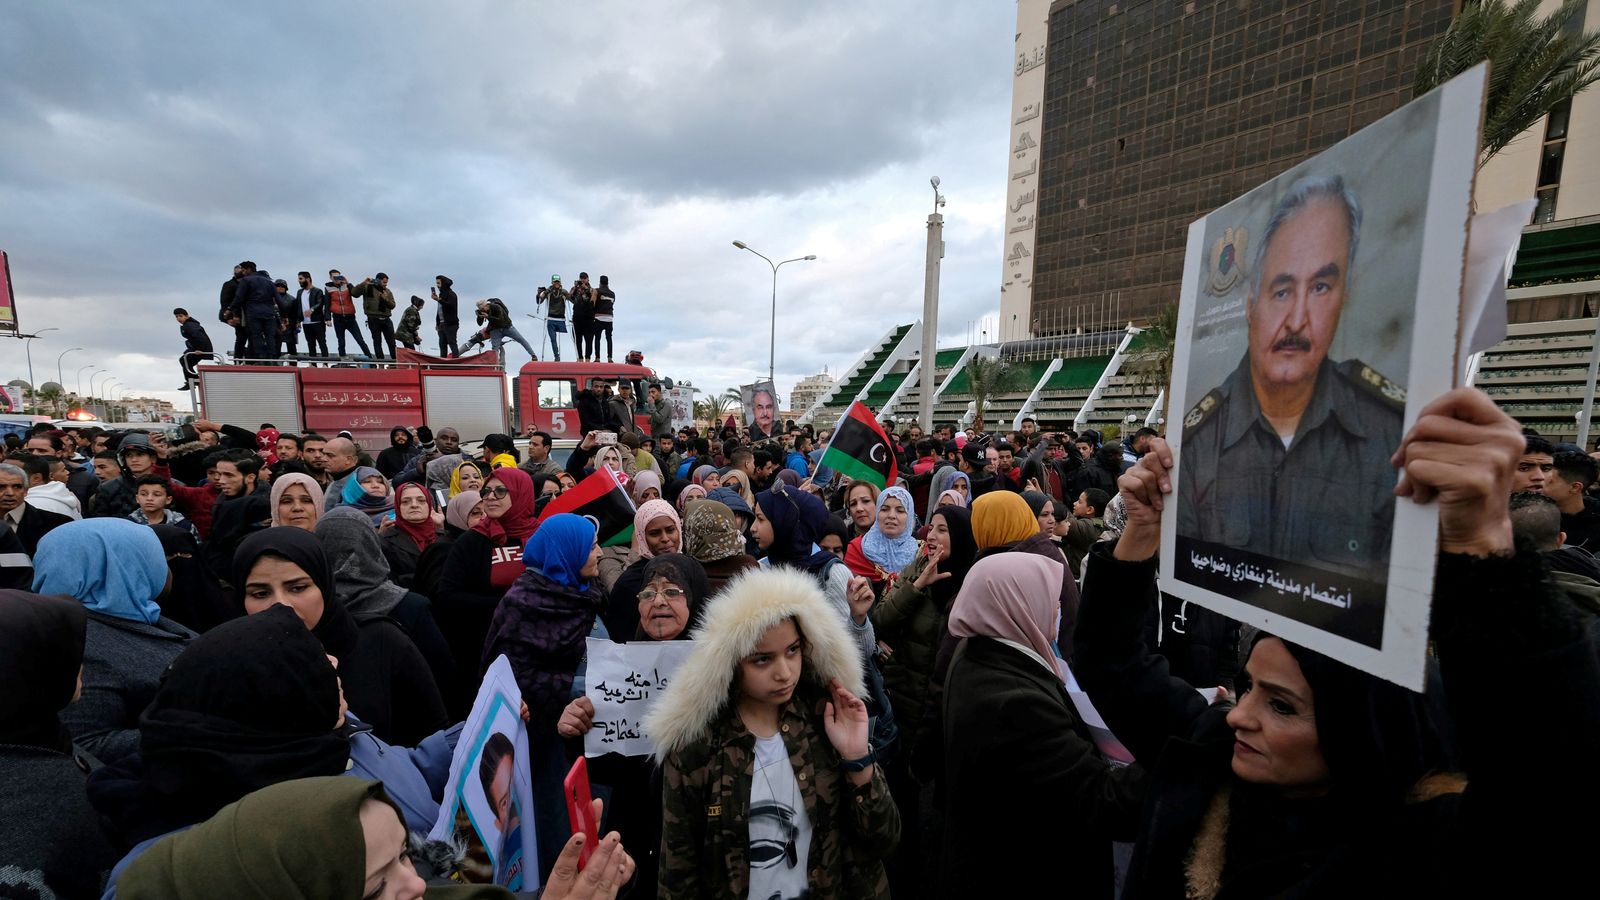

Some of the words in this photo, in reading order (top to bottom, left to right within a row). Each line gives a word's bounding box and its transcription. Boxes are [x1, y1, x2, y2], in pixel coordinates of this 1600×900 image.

[312, 392, 350, 405] الوطنية
[353, 392, 389, 403] السلامة
[349, 415, 383, 427] بنغازي
[552, 411, 566, 434] 5
[1191, 550, 1231, 577] وضواحيها
[1231, 562, 1265, 588] بنغازي
[1266, 569, 1301, 594] مدينة
